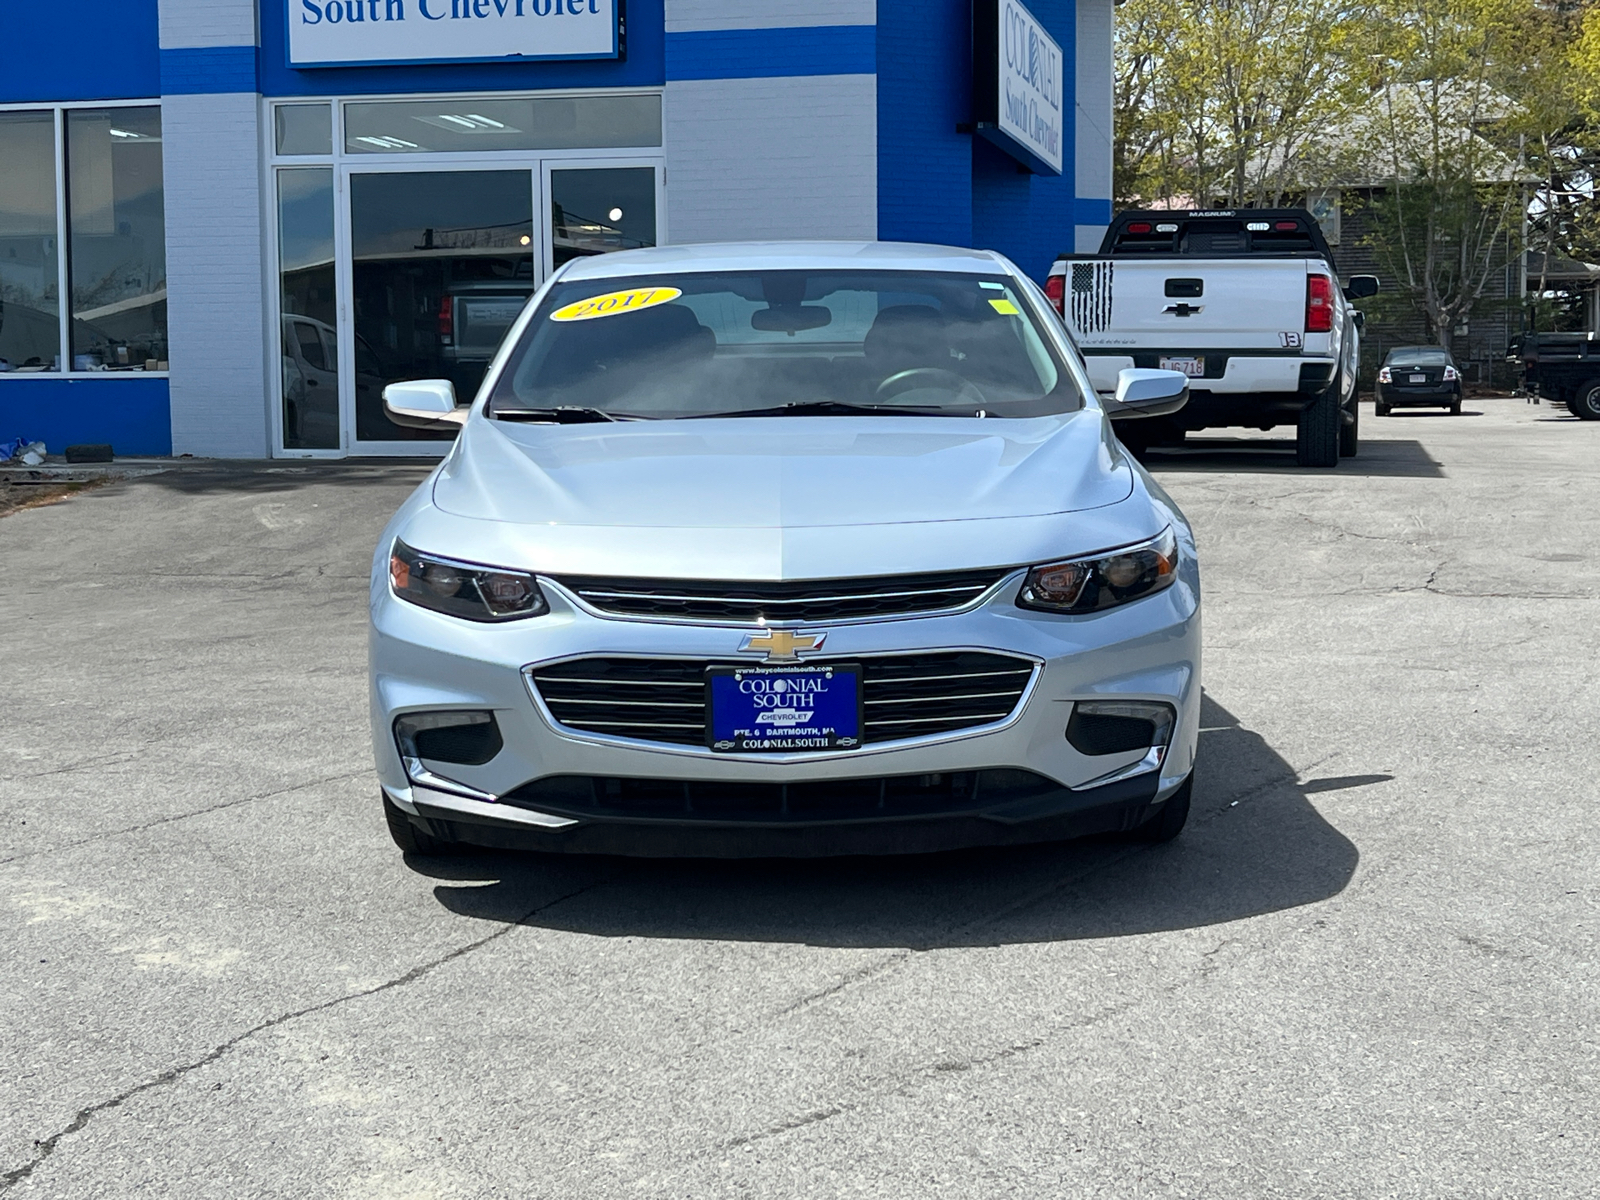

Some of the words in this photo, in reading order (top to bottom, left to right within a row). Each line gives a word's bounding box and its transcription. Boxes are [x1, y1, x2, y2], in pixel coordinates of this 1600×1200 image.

[302, 0, 405, 25] South
[573, 290, 657, 318] 2017
[1278, 331, 1301, 348] 13
[1183, 362, 1203, 374] 718
[735, 666, 833, 674] www.buycolonialsouth.com
[739, 679, 828, 693] COLONIAL
[753, 693, 814, 707] SOUTH
[754, 729, 760, 737] 6
[766, 727, 820, 736] DARTMOUTH,
[742, 739, 794, 748] COLONIAL
[795, 738, 828, 747] SOUTH
